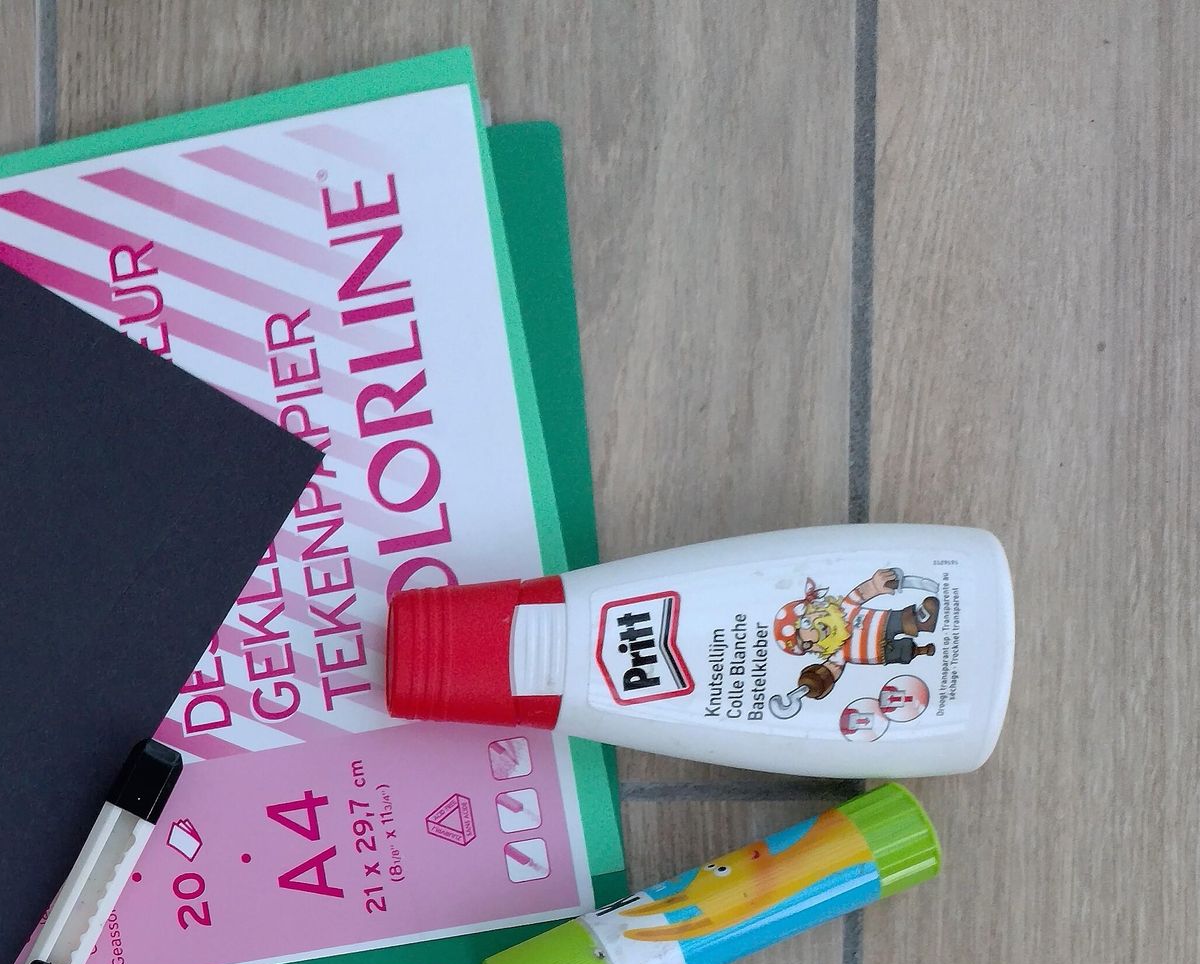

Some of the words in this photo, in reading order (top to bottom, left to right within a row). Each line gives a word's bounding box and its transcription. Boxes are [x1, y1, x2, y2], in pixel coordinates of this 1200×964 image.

[616, 612, 661, 692] Pritt
[704, 627, 728, 717] Knutsellijm
[729, 613, 747, 676] Blanche
[748, 622, 769, 721] Bastelkleber
[179, 630, 233, 734] DE
[726, 680, 745, 719] Colle
[351, 760, 366, 788] cm
[266, 790, 344, 898] A4
[349, 799, 377, 853] 29,7
[364, 861, 381, 877] x
[173, 872, 212, 930] 20
[365, 886, 387, 914] 21
